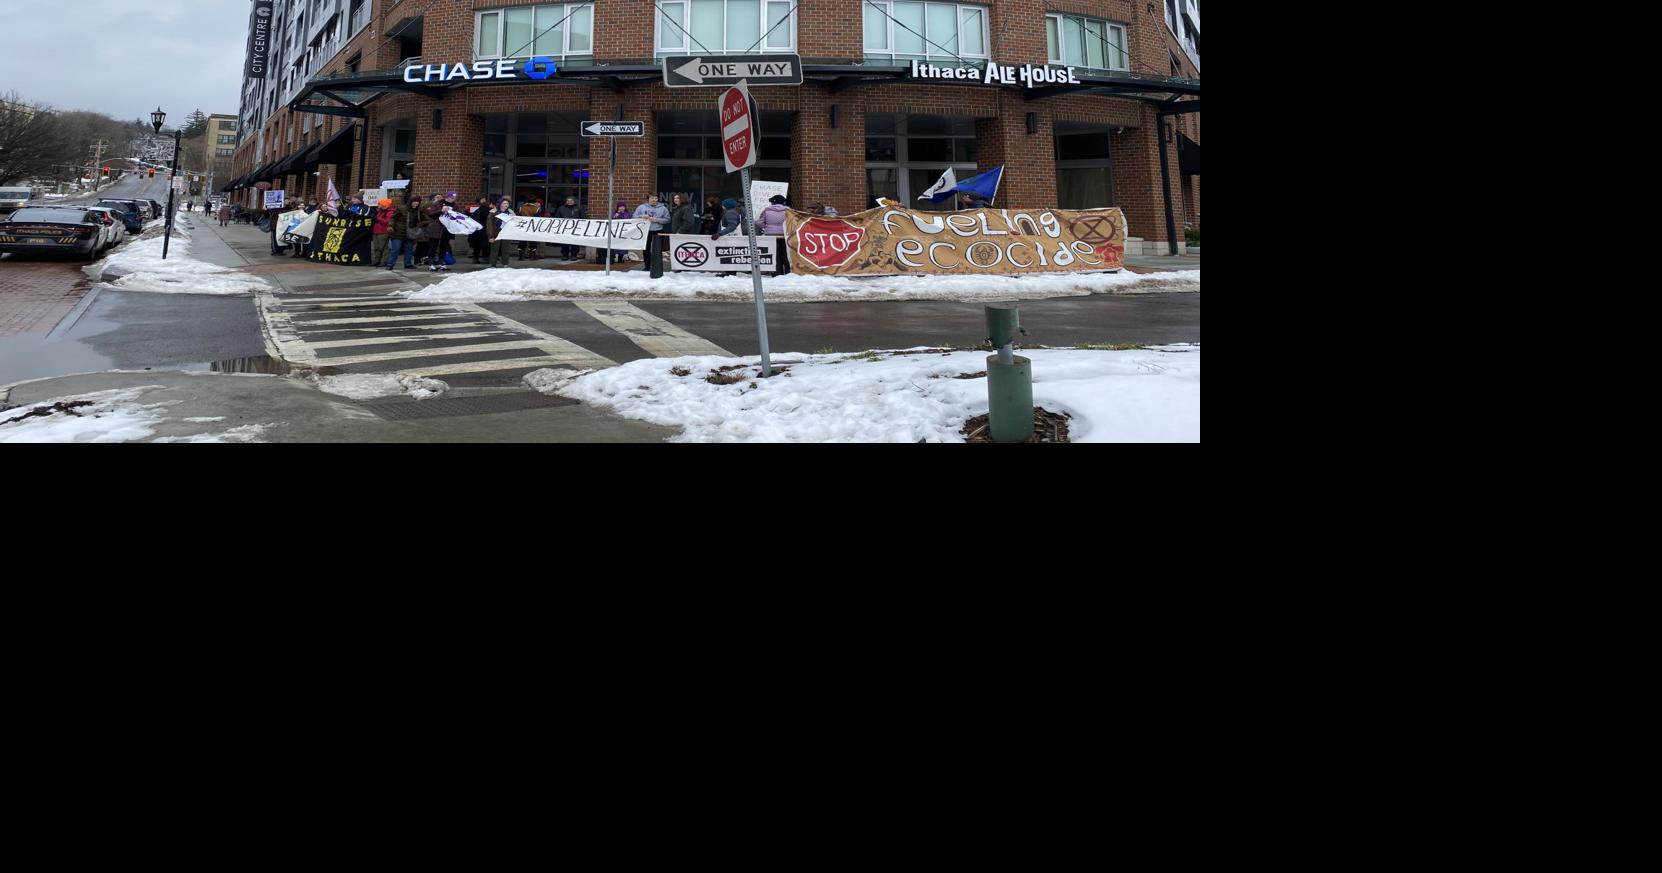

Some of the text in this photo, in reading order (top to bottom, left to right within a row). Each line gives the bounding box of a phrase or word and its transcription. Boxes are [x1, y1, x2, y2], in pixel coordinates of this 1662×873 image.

[252, 18, 267, 73] CITY CENTRE
[403, 59, 518, 83] CHASE
[698, 63, 788, 76] ONE WAY
[912, 60, 980, 79] Ithaca
[984, 62, 1016, 84] ALE
[723, 97, 744, 122] DO NOT
[729, 135, 747, 155] ENTER
[319, 215, 372, 228] SUNRISE
[514, 218, 647, 240] #NOPIPELINES
[717, 246, 762, 256] extinctin
[804, 231, 860, 255] STOP
[310, 250, 361, 263] ITHACA
